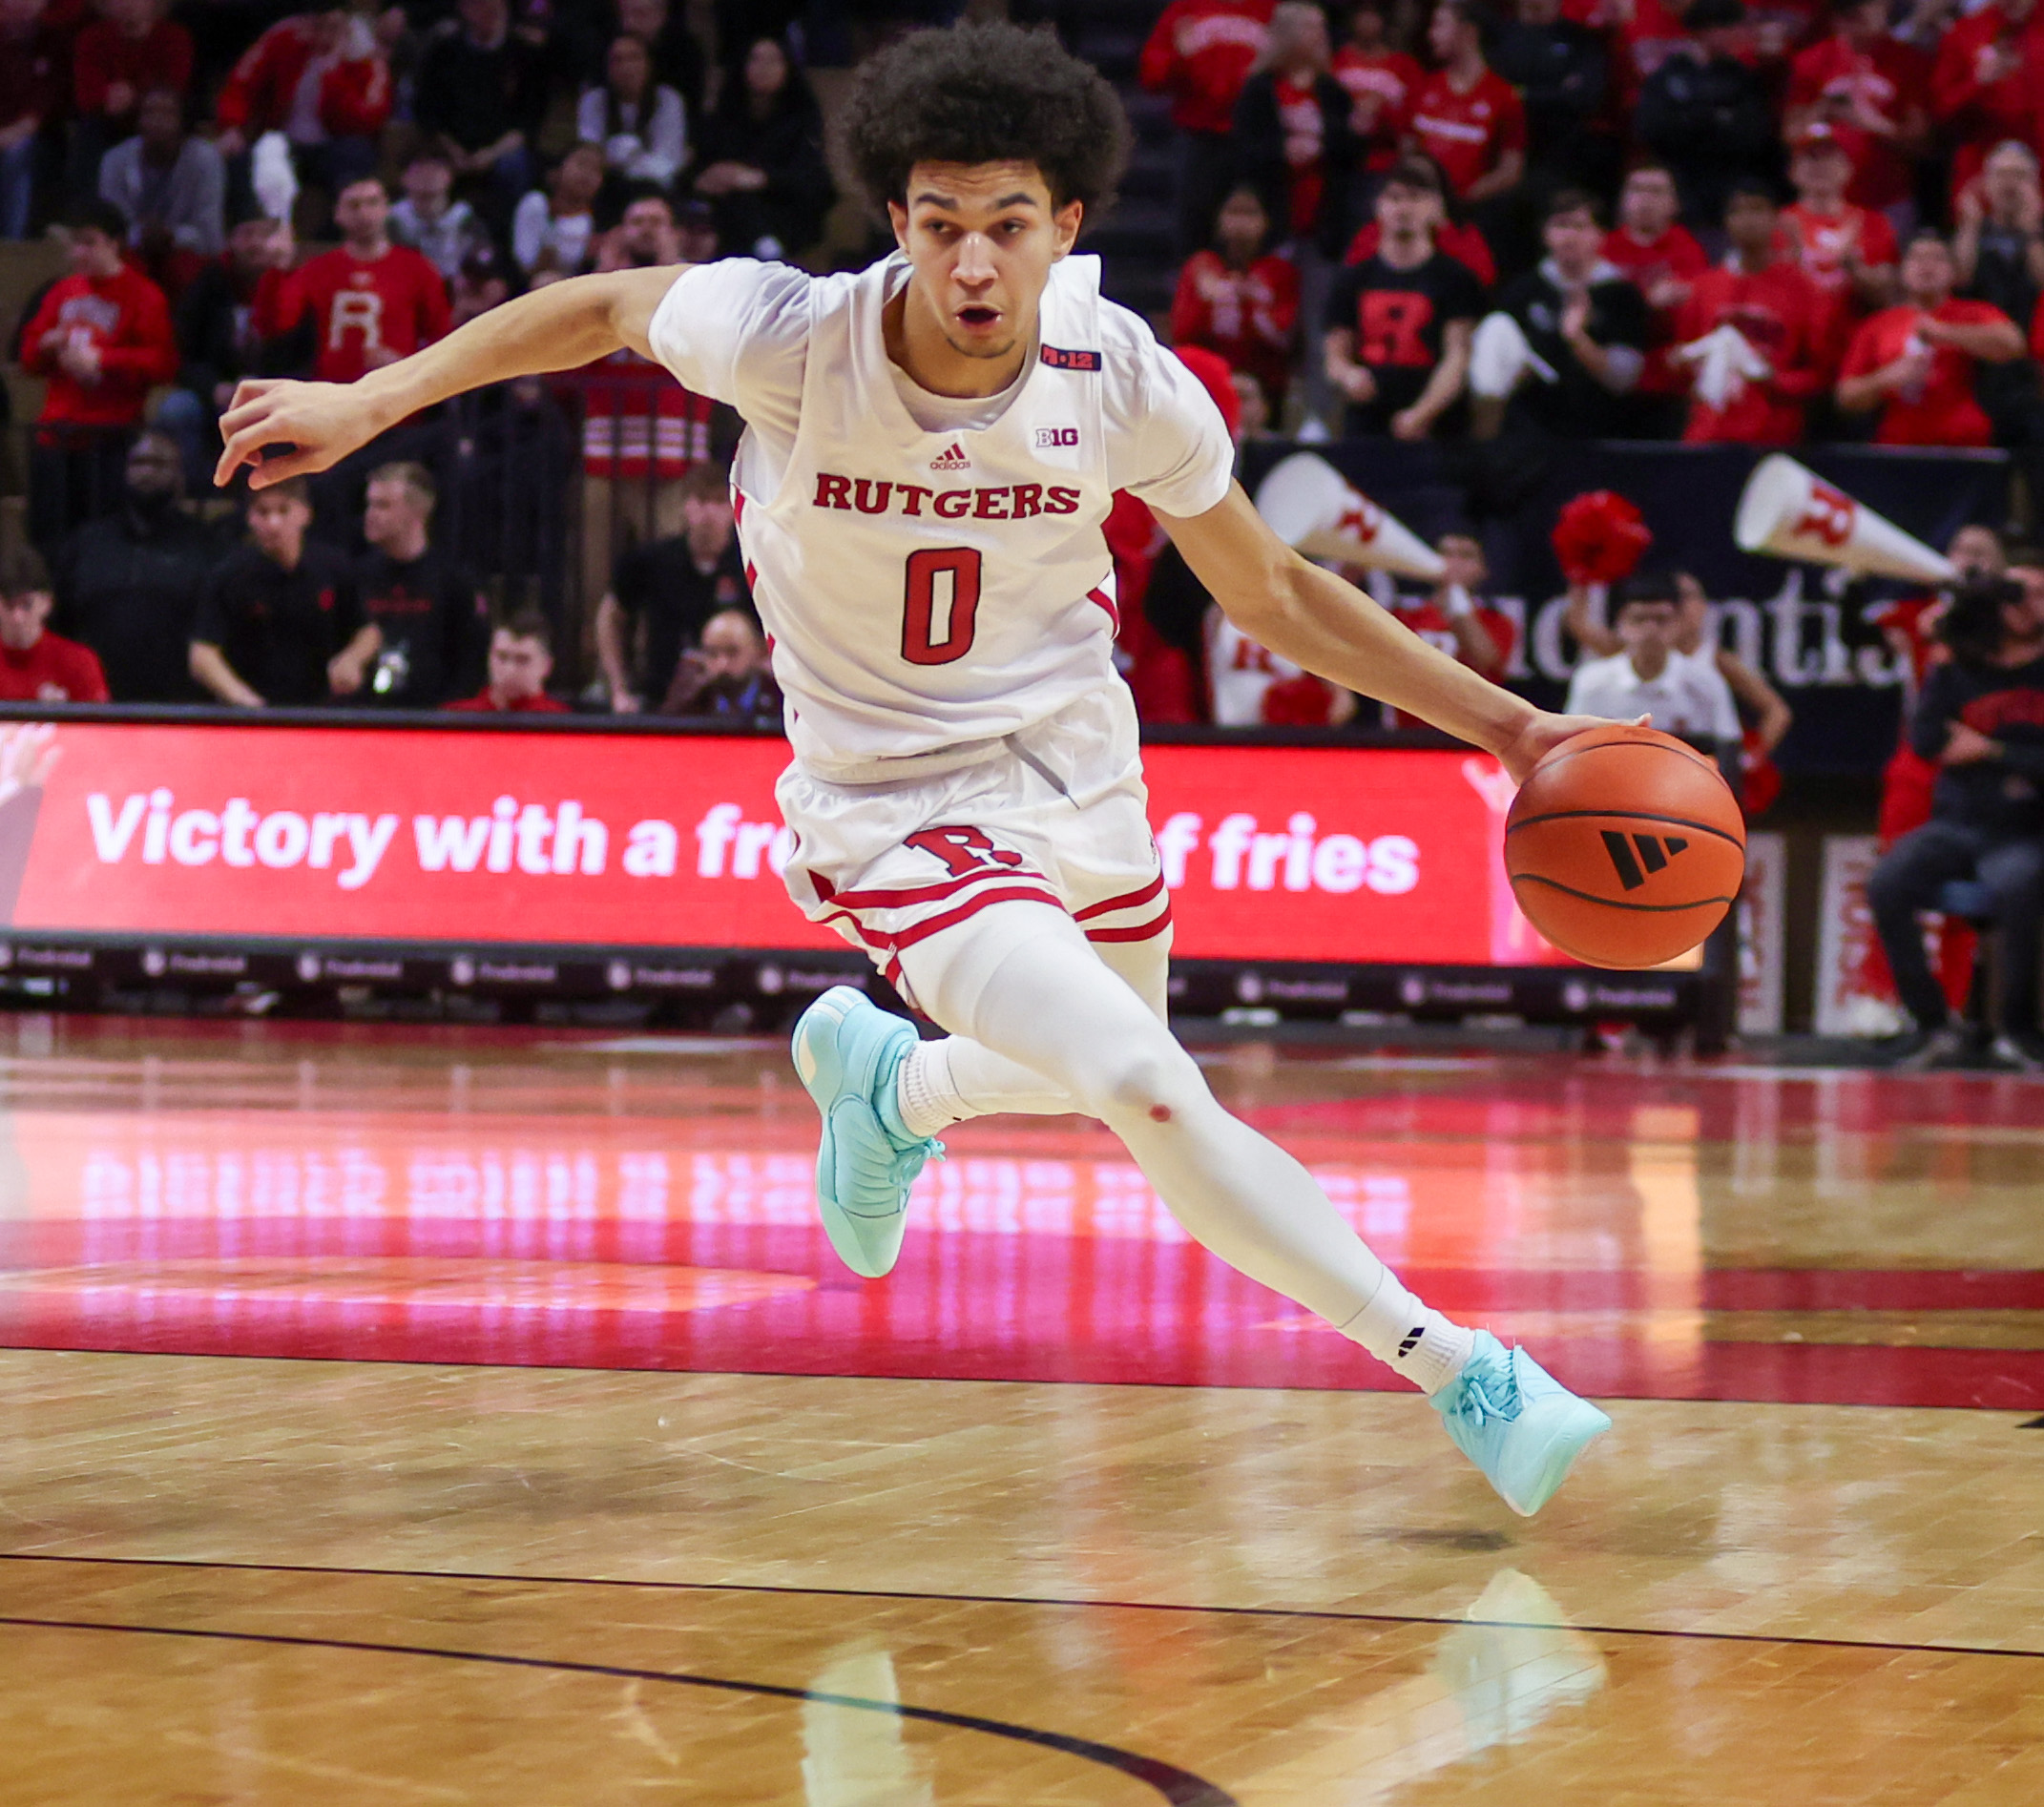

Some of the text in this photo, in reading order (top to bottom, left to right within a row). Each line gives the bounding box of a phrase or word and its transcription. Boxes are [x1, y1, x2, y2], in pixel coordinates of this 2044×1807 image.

[929, 460, 971, 470] adidas
[813, 472, 1081, 519] RUTGERS
[901, 547, 982, 666] 0
[86, 788, 398, 889] Victory
[413, 796, 609, 876] with
[623, 818, 678, 877] a
[1209, 812, 1420, 894] fries
[903, 825, 1023, 878] R
